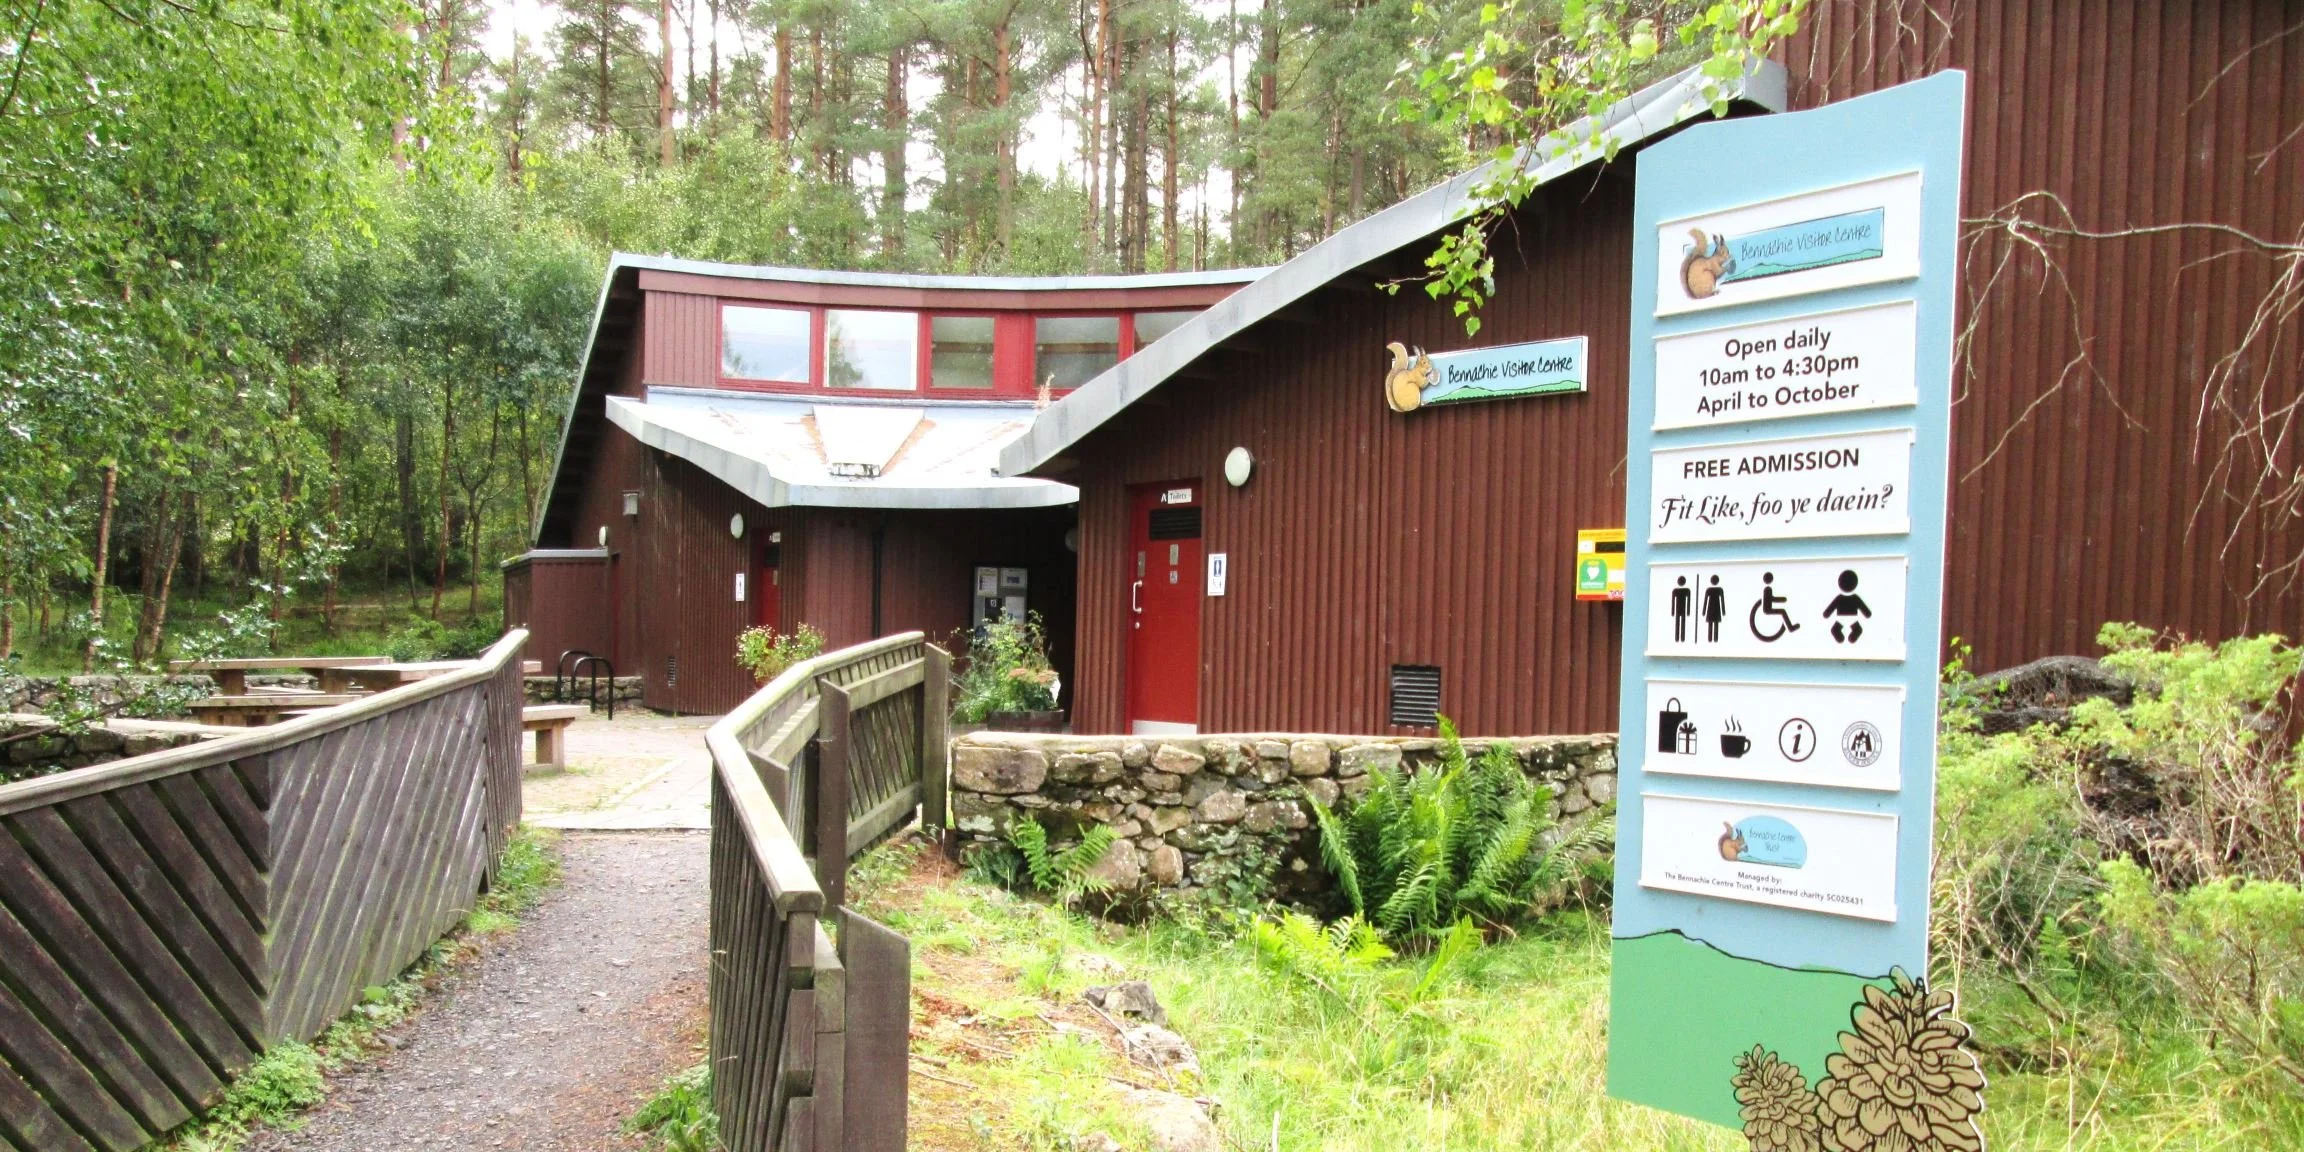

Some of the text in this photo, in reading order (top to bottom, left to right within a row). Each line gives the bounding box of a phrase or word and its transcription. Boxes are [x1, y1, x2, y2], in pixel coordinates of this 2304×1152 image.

[1725, 326, 1831, 360] Open daily
[1699, 354, 1859, 387] 10am to 4:30pm
[1697, 381, 1860, 417] April to October
[1683, 448, 1860, 479] FREE ADMISSION
[1658, 483, 1894, 529] Fit Like, foo ye daein?
[1665, 872, 1675, 880] The
[1677, 873, 1710, 884] Bennachie
[1711, 878, 1734, 888] Centre
[1736, 881, 1754, 891] Trust,
[1762, 885, 1798, 897] registered
[1800, 890, 1824, 902] charity
[1826, 893, 1864, 905] SC025431
[1738, 871, 1783, 885] Managed by:
